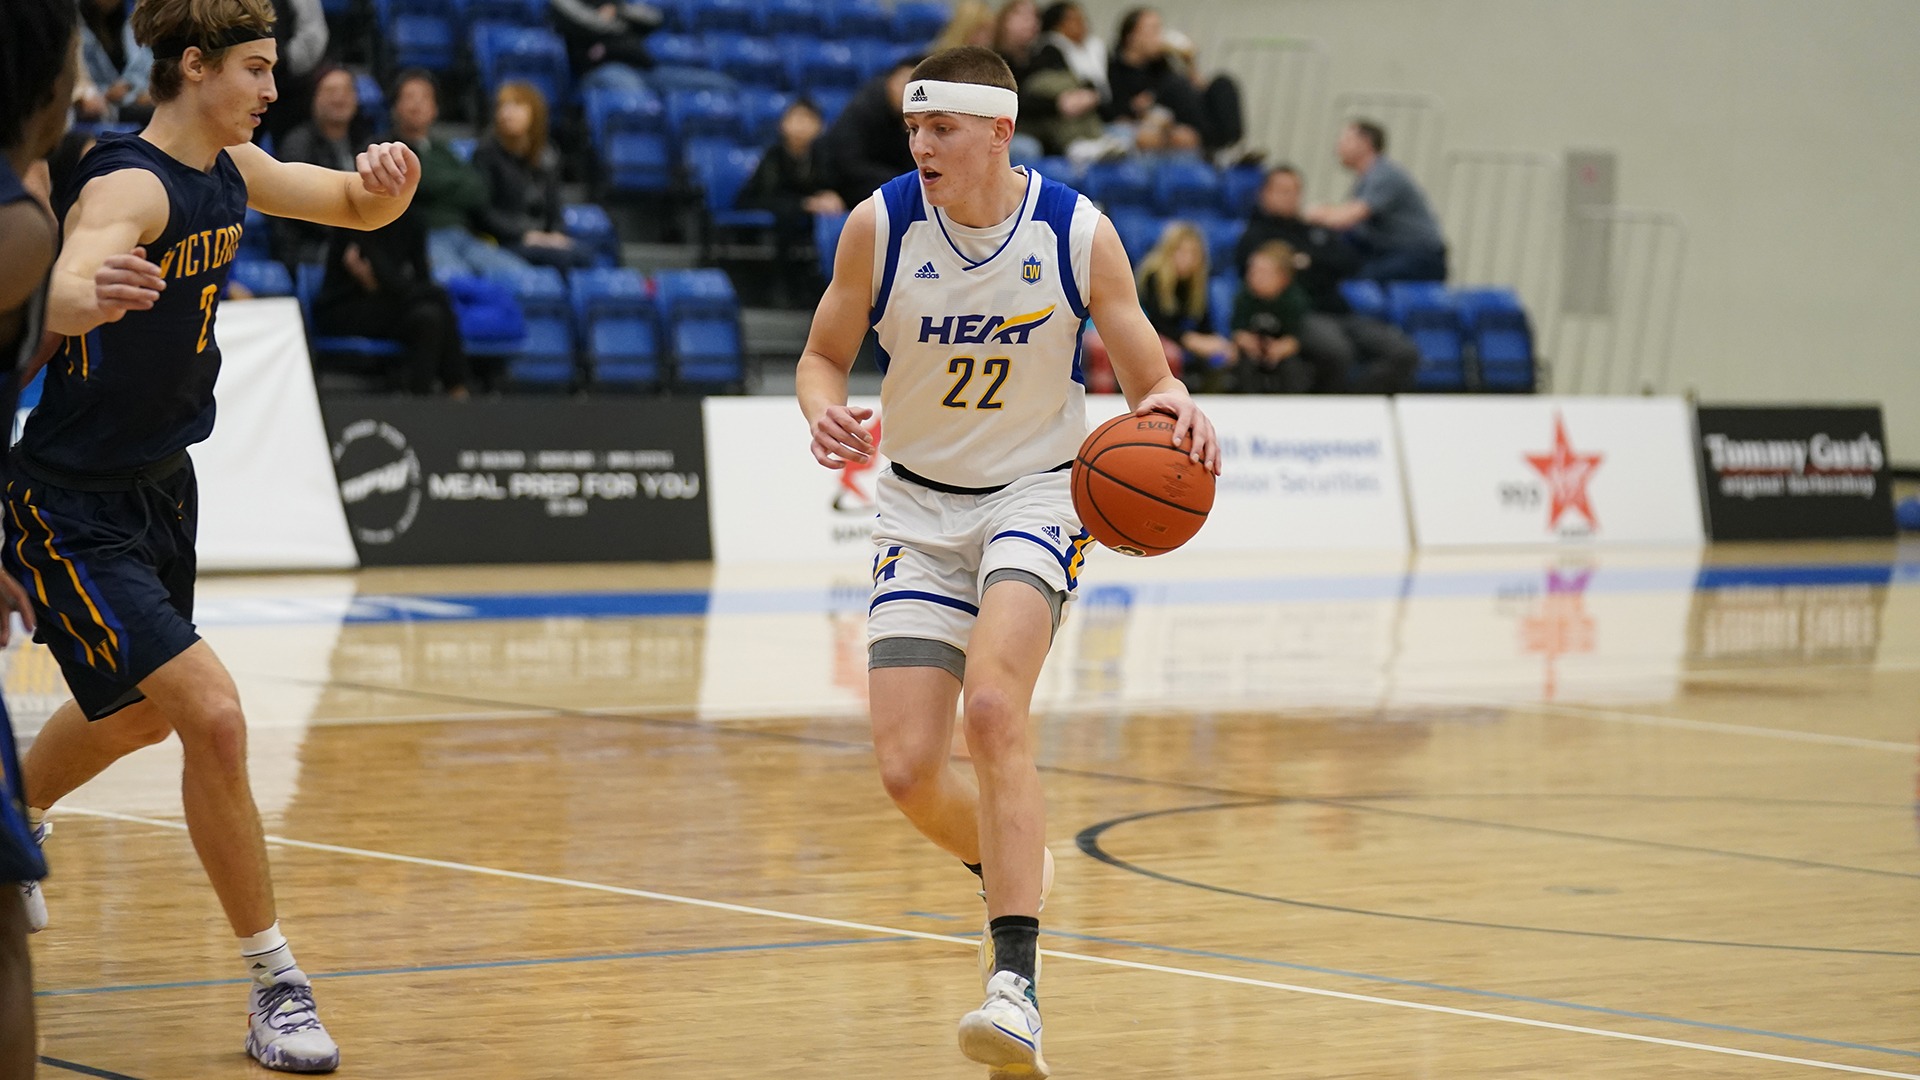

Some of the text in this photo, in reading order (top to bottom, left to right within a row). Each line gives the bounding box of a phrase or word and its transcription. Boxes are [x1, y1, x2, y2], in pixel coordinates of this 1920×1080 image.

[914, 271, 940, 280] adidas
[1023, 264, 1041, 280] CW
[196, 284, 217, 353] 2
[917, 303, 1056, 345] HEAT
[940, 355, 1012, 411] 22
[427, 473, 506, 499] MEAL
[582, 472, 637, 499] FOR
[639, 472, 700, 499] YOU
[1041, 526, 1061, 546] adidas
